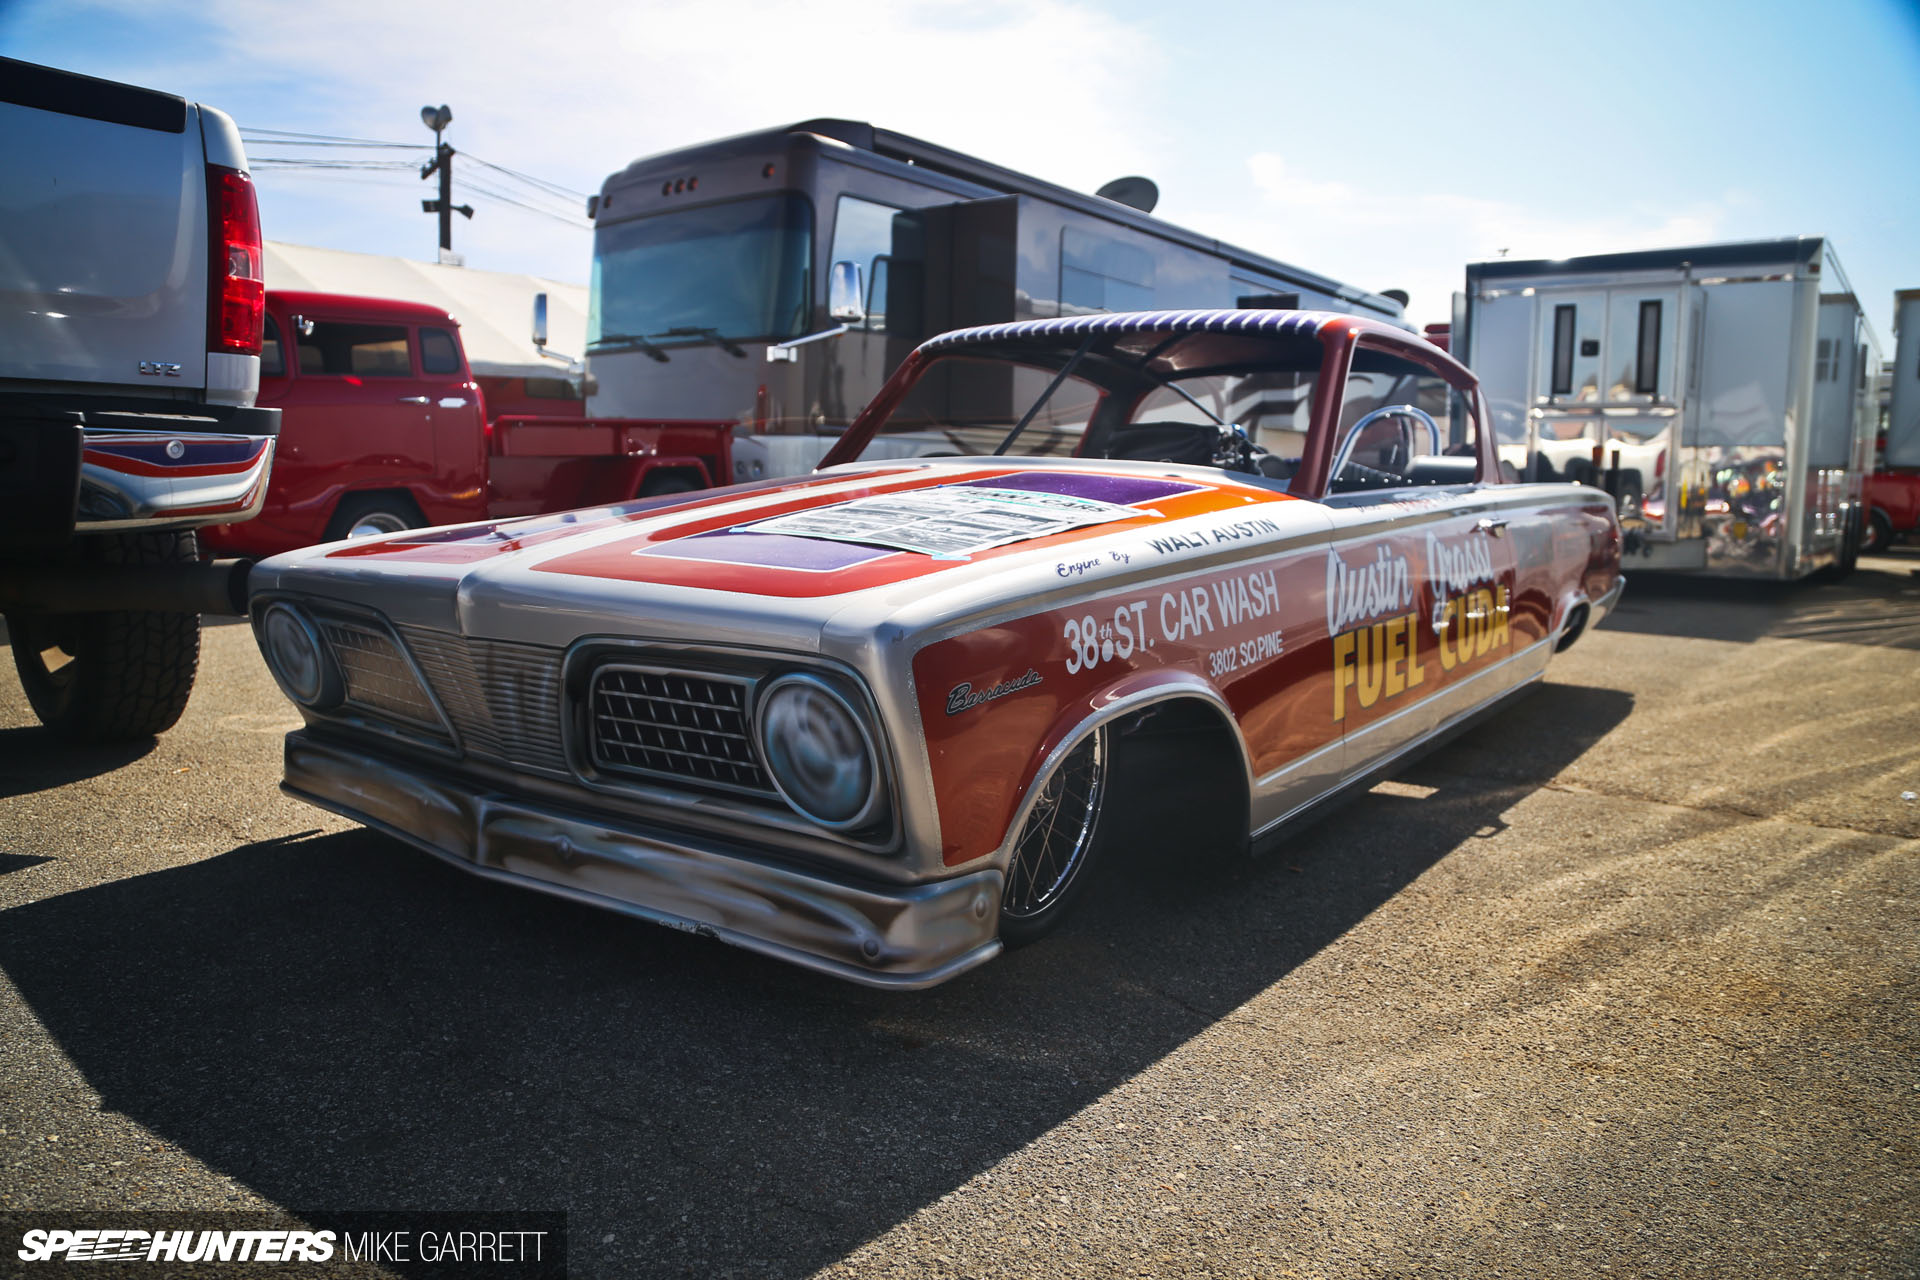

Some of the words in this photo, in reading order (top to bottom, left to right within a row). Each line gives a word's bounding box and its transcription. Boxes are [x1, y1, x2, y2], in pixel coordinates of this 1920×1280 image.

[139, 361, 181, 377] LTZ
[1040, 499, 1110, 512] CARS
[1057, 558, 1102, 578] Engine
[1109, 551, 1132, 565] By
[1146, 532, 1210, 555] WALT
[1212, 517, 1280, 543] AUSTIN
[1114, 601, 1155, 660] ST.
[1160, 585, 1215, 642] CAR
[1212, 569, 1281, 632] WASH
[1326, 546, 1413, 636] Austin
[1209, 646, 1238, 678] 3802
[1333, 612, 1425, 721] FUEL
[1440, 584, 1509, 671] CUDA
[945, 668, 1043, 717] Barracuda
